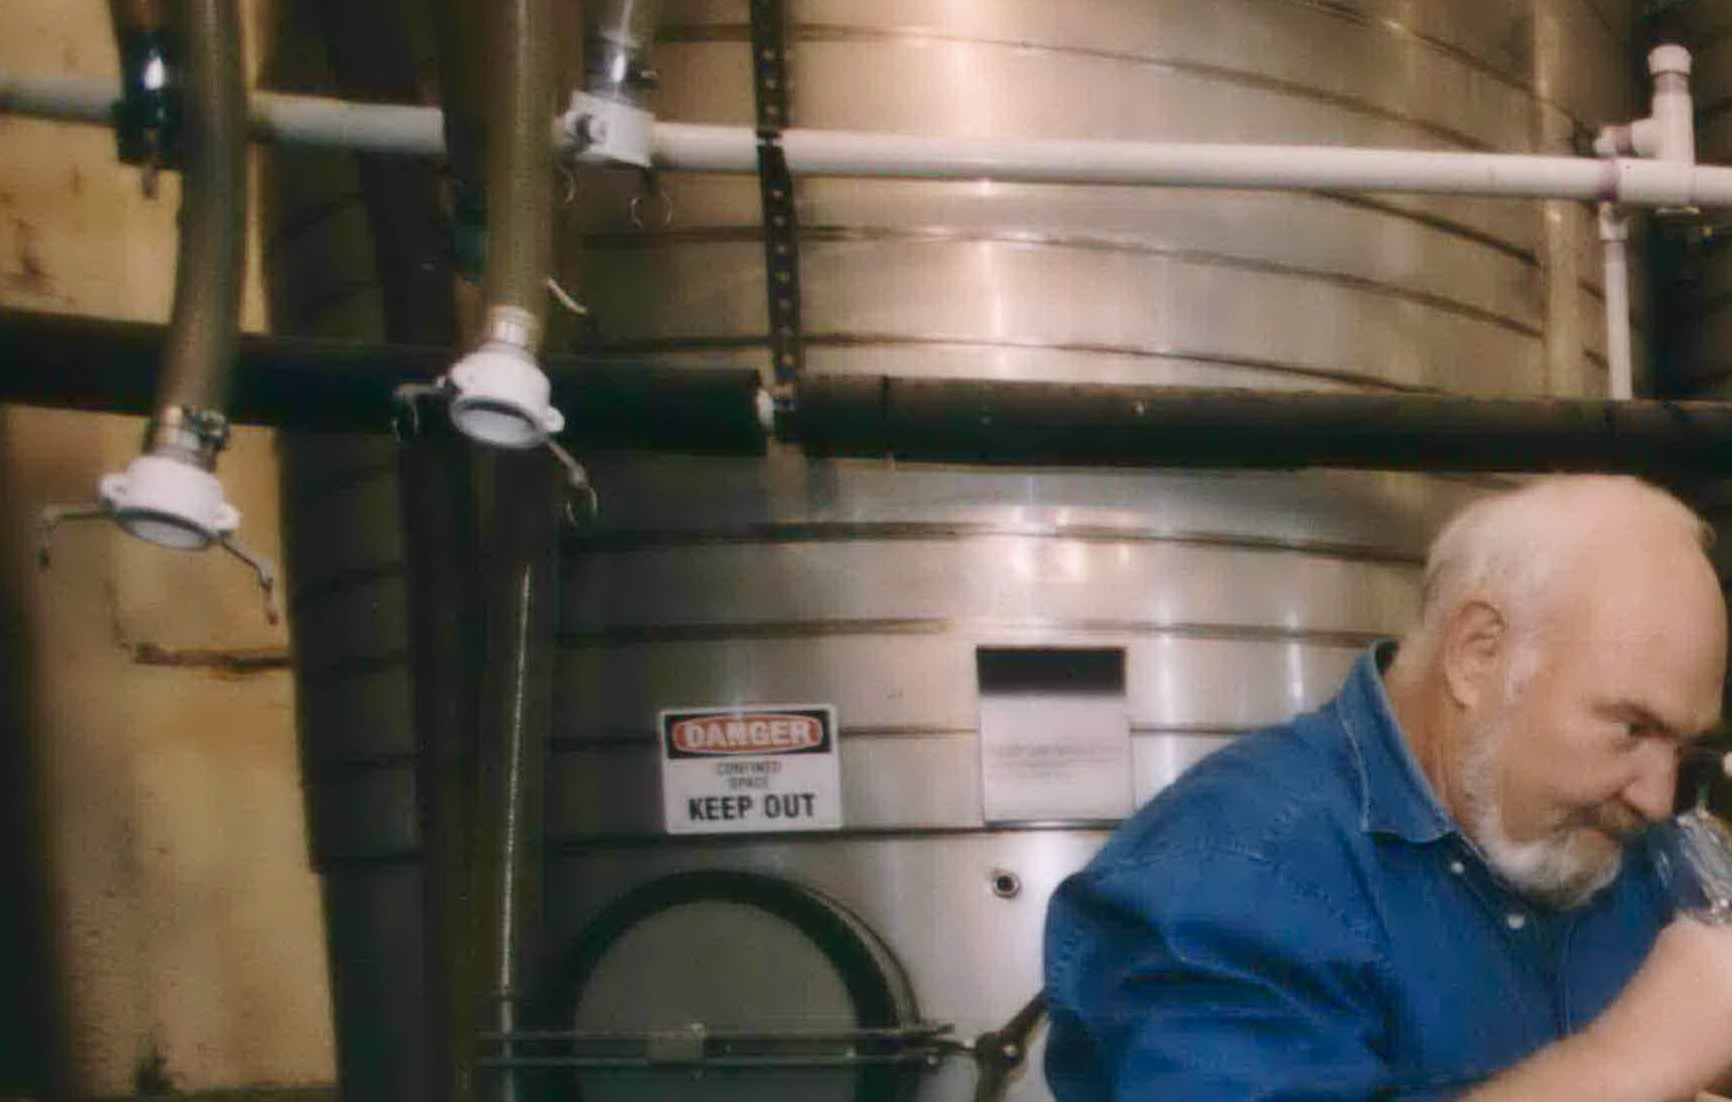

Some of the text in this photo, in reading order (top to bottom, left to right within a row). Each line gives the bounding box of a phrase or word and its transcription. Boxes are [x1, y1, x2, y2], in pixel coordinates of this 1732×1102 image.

[683, 718, 811, 748] DANGER
[688, 793, 816, 821] KEEP OUT
